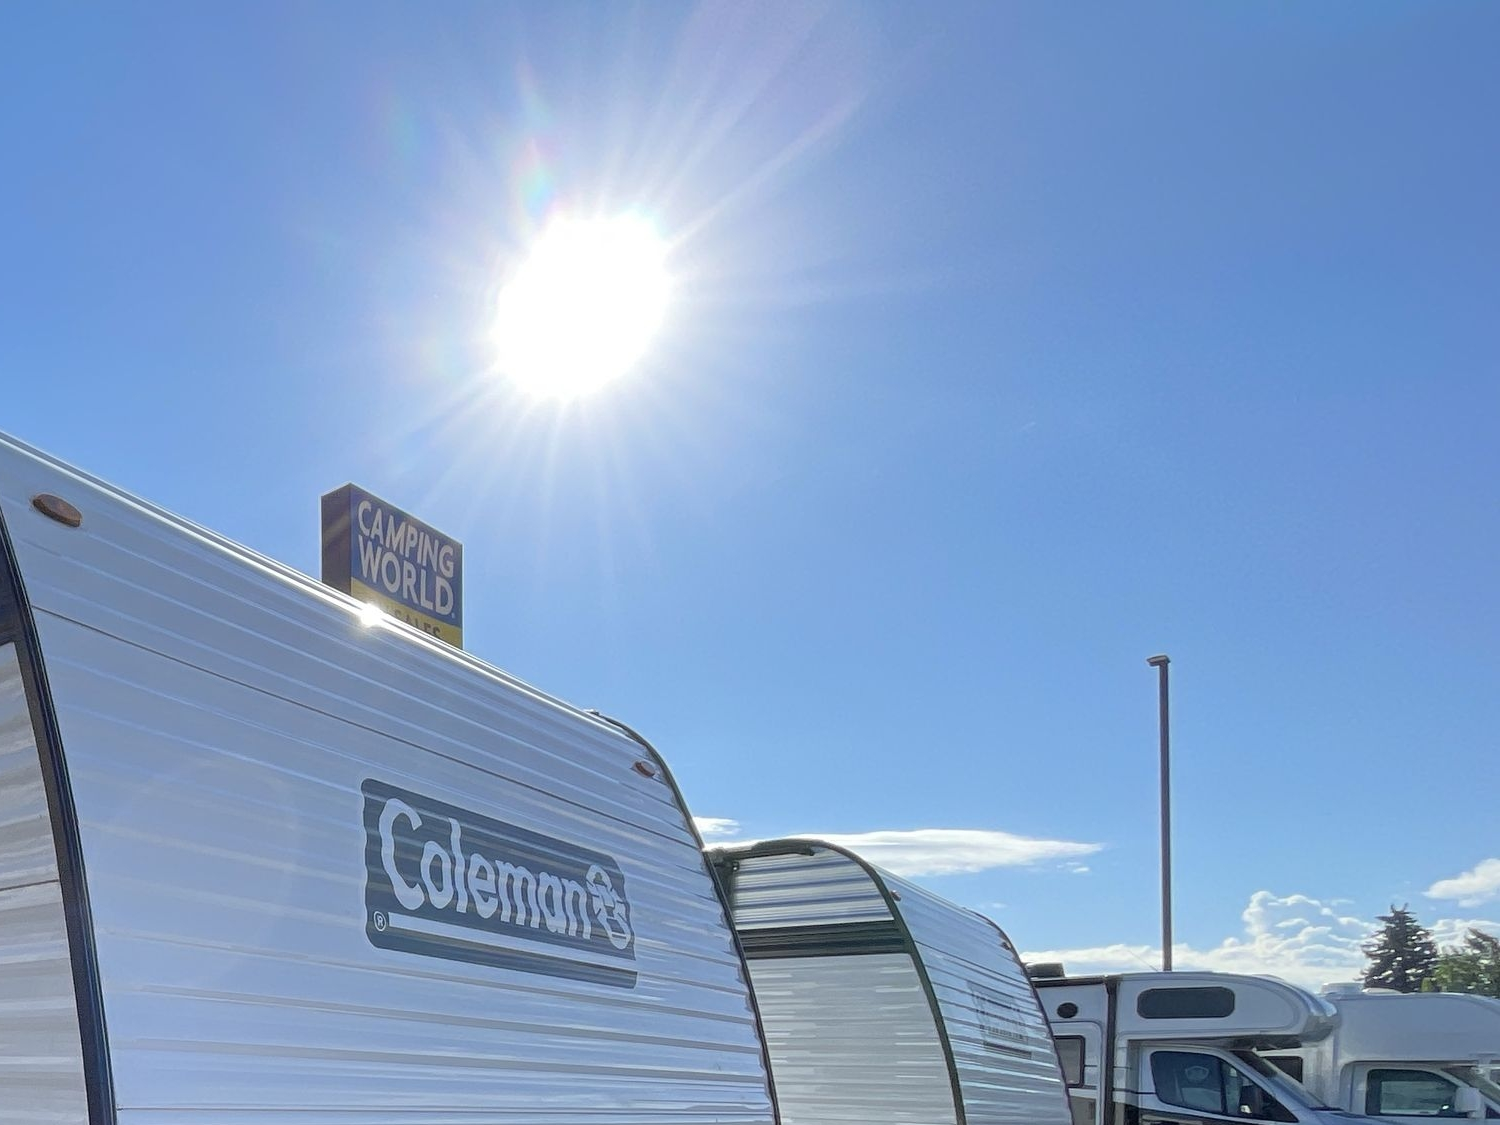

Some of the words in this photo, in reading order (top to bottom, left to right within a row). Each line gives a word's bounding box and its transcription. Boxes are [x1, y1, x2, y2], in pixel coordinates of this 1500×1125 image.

[358, 500, 454, 578] CAMPING
[358, 535, 454, 616] WORLD
[379, 798, 591, 940] Coleman
